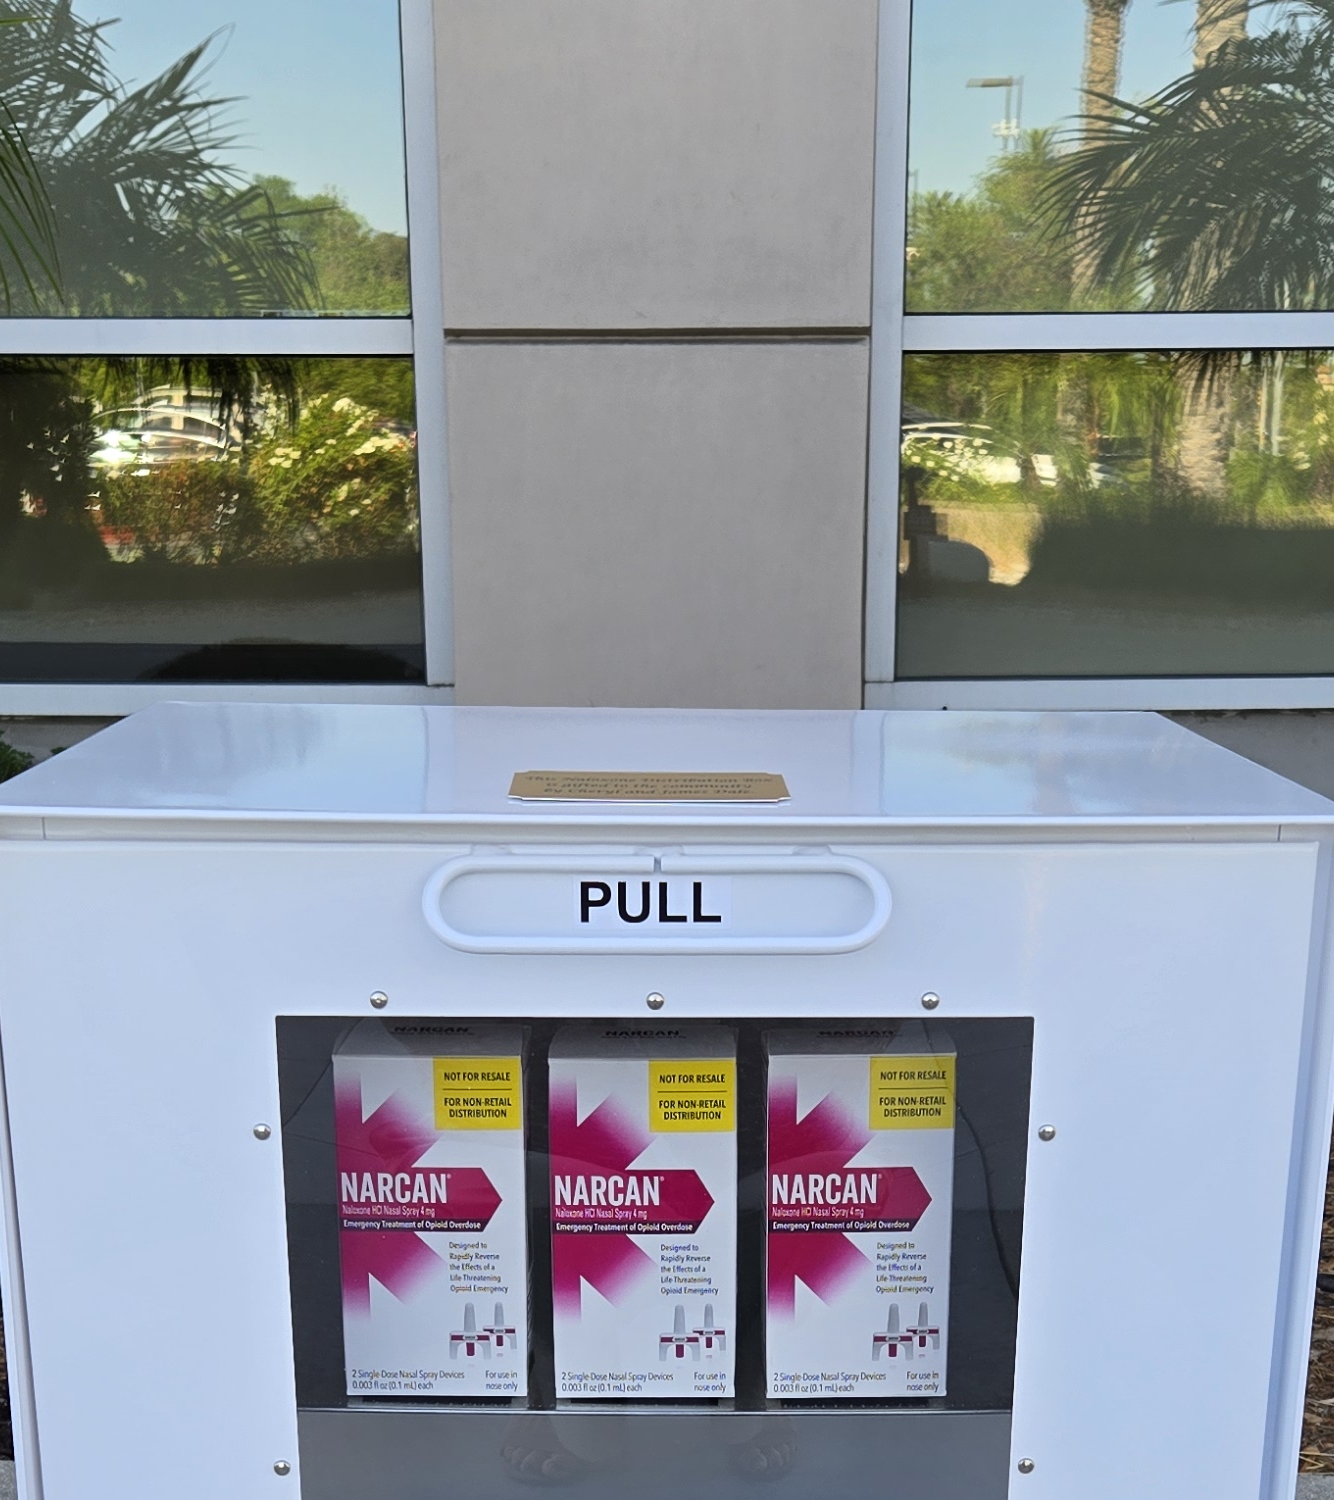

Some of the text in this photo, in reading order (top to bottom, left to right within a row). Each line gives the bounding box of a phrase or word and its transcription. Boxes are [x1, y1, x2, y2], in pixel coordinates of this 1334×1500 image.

[581, 882, 721, 923] PULL
[444, 1072, 510, 1081] NOT FOR RESALE
[660, 1074, 725, 1083] NOT FOR RESALE
[881, 1071, 946, 1080] NOT FOR RESALE
[444, 1098, 512, 1106] FOR NON-RETAIL
[659, 1100, 726, 1109] FOR NON-RETAIL
[879, 1097, 946, 1106] FOR NON-RETAIL
[449, 1109, 507, 1118] DISTRIBUTION
[664, 1111, 721, 1120] DISTRIBUTION
[884, 1108, 941, 1117] DISTRIBUTION
[597, 1208, 613, 1218] Nasal
[615, 1208, 632, 1220] Spray
[633, 1209, 637, 1217] 4
[813, 1207, 830, 1216] Nasal
[832, 1207, 849, 1218] Spray
[850, 1207, 853, 1216] 4
[344, 1220, 380, 1229] Emergency
[382, 1220, 415, 1228] Treatment
[426, 1221, 447, 1229] Opioid
[556, 1223, 593, 1232] Emergency
[594, 1223, 628, 1231] Treatment
[630, 1223, 636, 1231] of
[638, 1224, 659, 1232] Opioid
[773, 1222, 809, 1231] Emergency
[854, 1222, 876, 1230] Opioid
[661, 1244, 690, 1252] Designed
[352, 1370, 356, 1378] 2
[419, 1371, 438, 1380] Spray
[562, 1372, 566, 1380] 2
[609, 1372, 627, 1380] Nasal
[628, 1373, 646, 1383] Spray
[694, 1372, 705, 1380] For
[719, 1372, 726, 1380] in
[774, 1373, 778, 1381] 2
[821, 1372, 839, 1381] Nasal
[841, 1373, 859, 1382] Spray
[861, 1372, 886, 1380] Devices
[353, 1381, 372, 1389] 0.003
[389, 1381, 402, 1390] (0.1
[404, 1381, 416, 1390] mL)
[503, 1382, 518, 1391] only
[598, 1383, 611, 1393] (0.1
[613, 1383, 625, 1393] mL)
[711, 1383, 726, 1393] only
[774, 1384, 794, 1392] 0.003
[810, 1383, 823, 1393] (0.1
[825, 1383, 837, 1393] mL)
[839, 1383, 854, 1392] each
[924, 1383, 939, 1392] only
